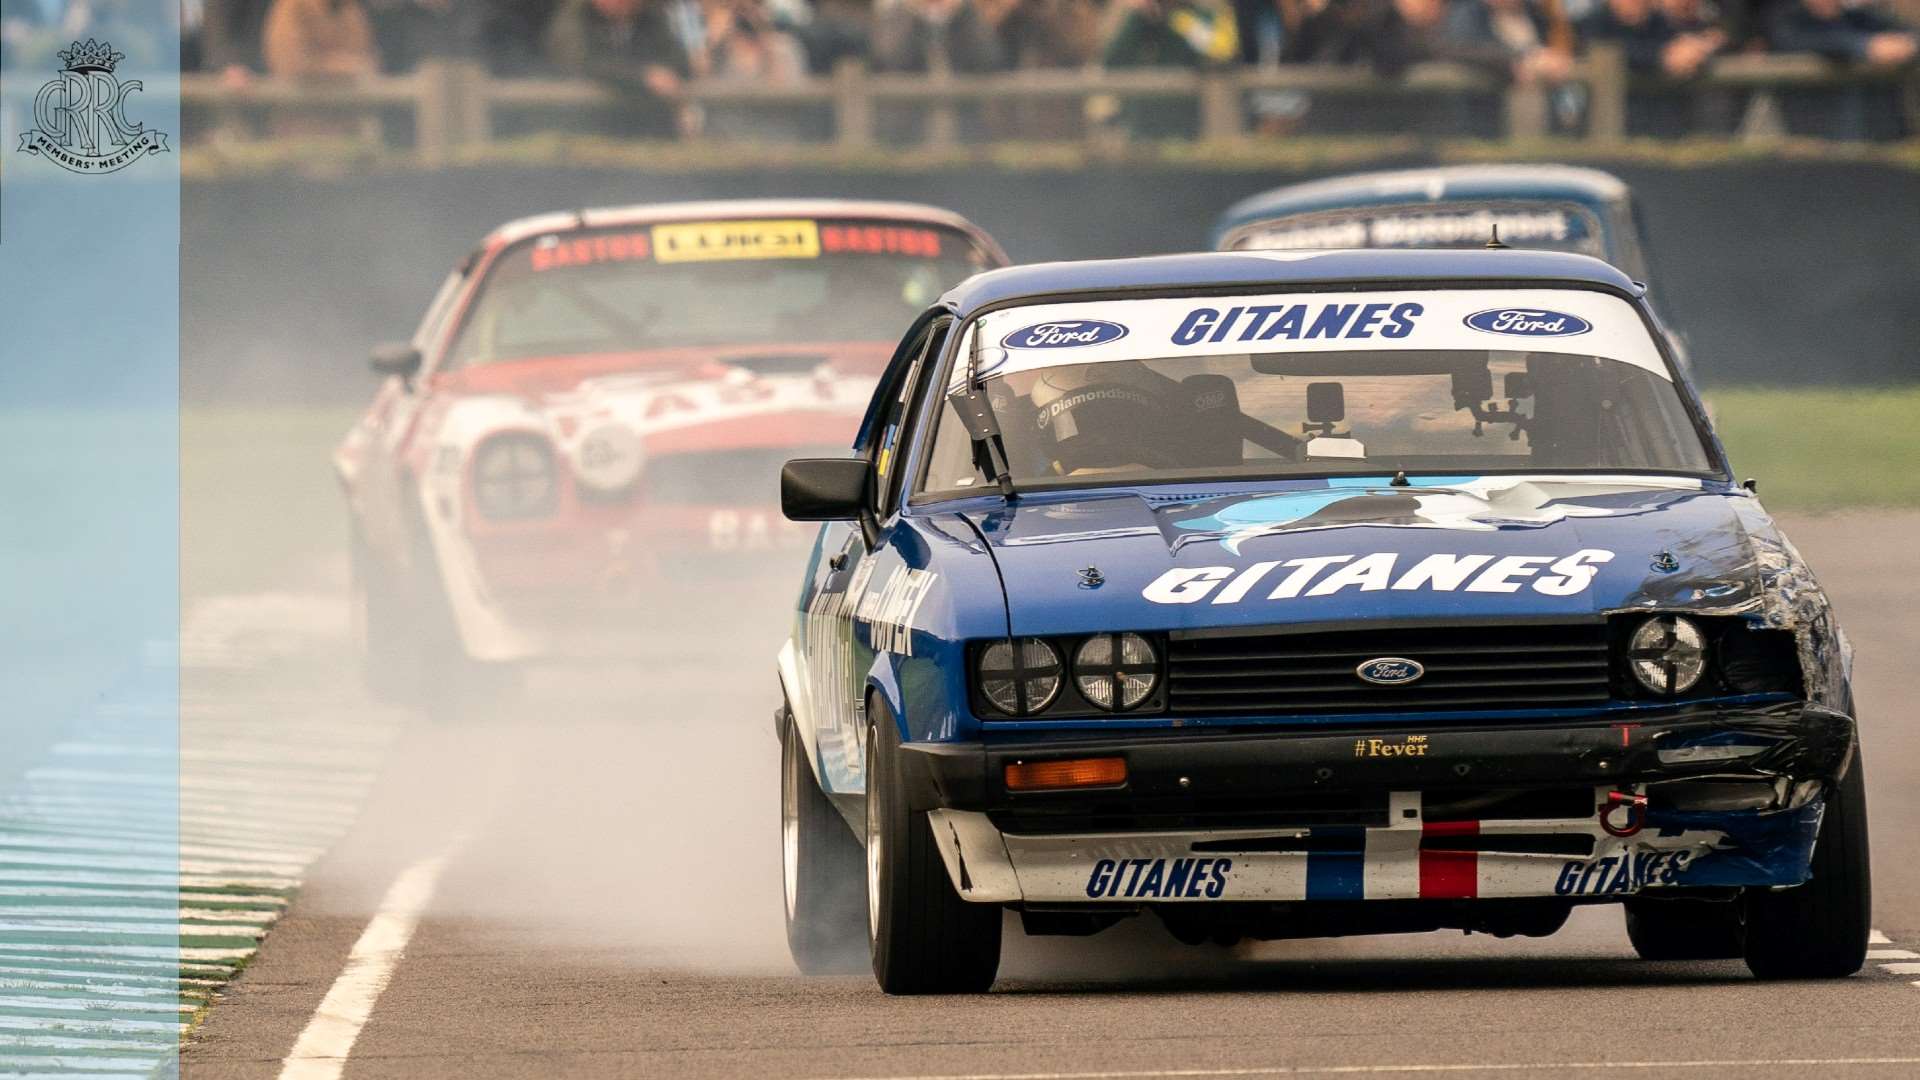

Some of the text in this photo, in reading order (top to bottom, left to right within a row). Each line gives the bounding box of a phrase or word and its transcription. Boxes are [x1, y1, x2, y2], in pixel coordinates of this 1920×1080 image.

[1026, 322, 1100, 346] Ford
[1171, 302, 1424, 346] GITANES
[1491, 310, 1566, 334] Ford
[1141, 549, 1616, 604] GITANES
[1372, 663, 1408, 678] Ford
[1086, 858, 1232, 898] GITANES
